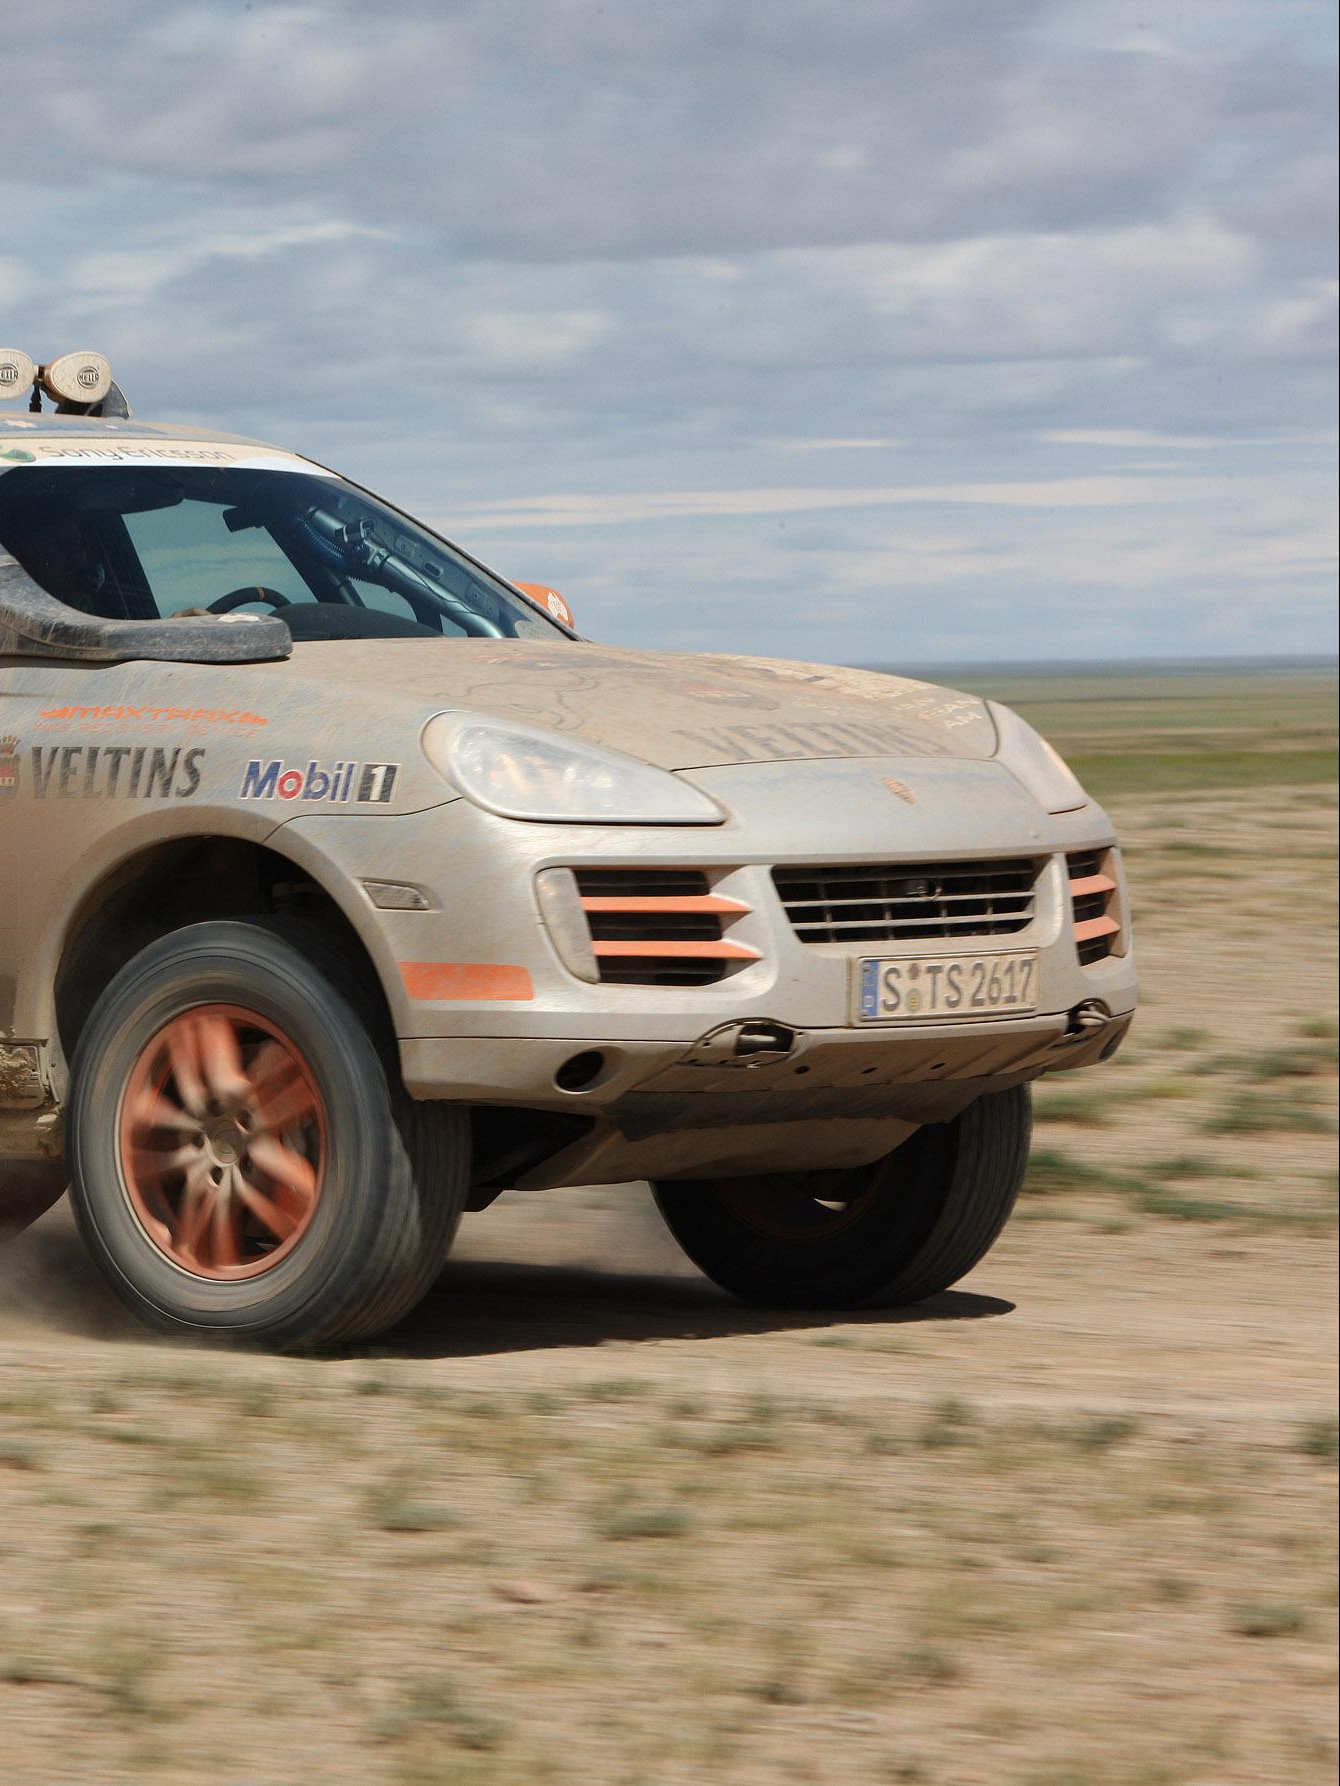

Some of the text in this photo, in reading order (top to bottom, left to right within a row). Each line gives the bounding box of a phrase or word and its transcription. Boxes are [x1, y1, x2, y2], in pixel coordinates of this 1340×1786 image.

[38, 446, 237, 461] Sony Ericsson
[31, 746, 206, 799] VELTINS
[239, 760, 358, 803] Mobil
[882, 958, 1035, 1011] S TS 2617
